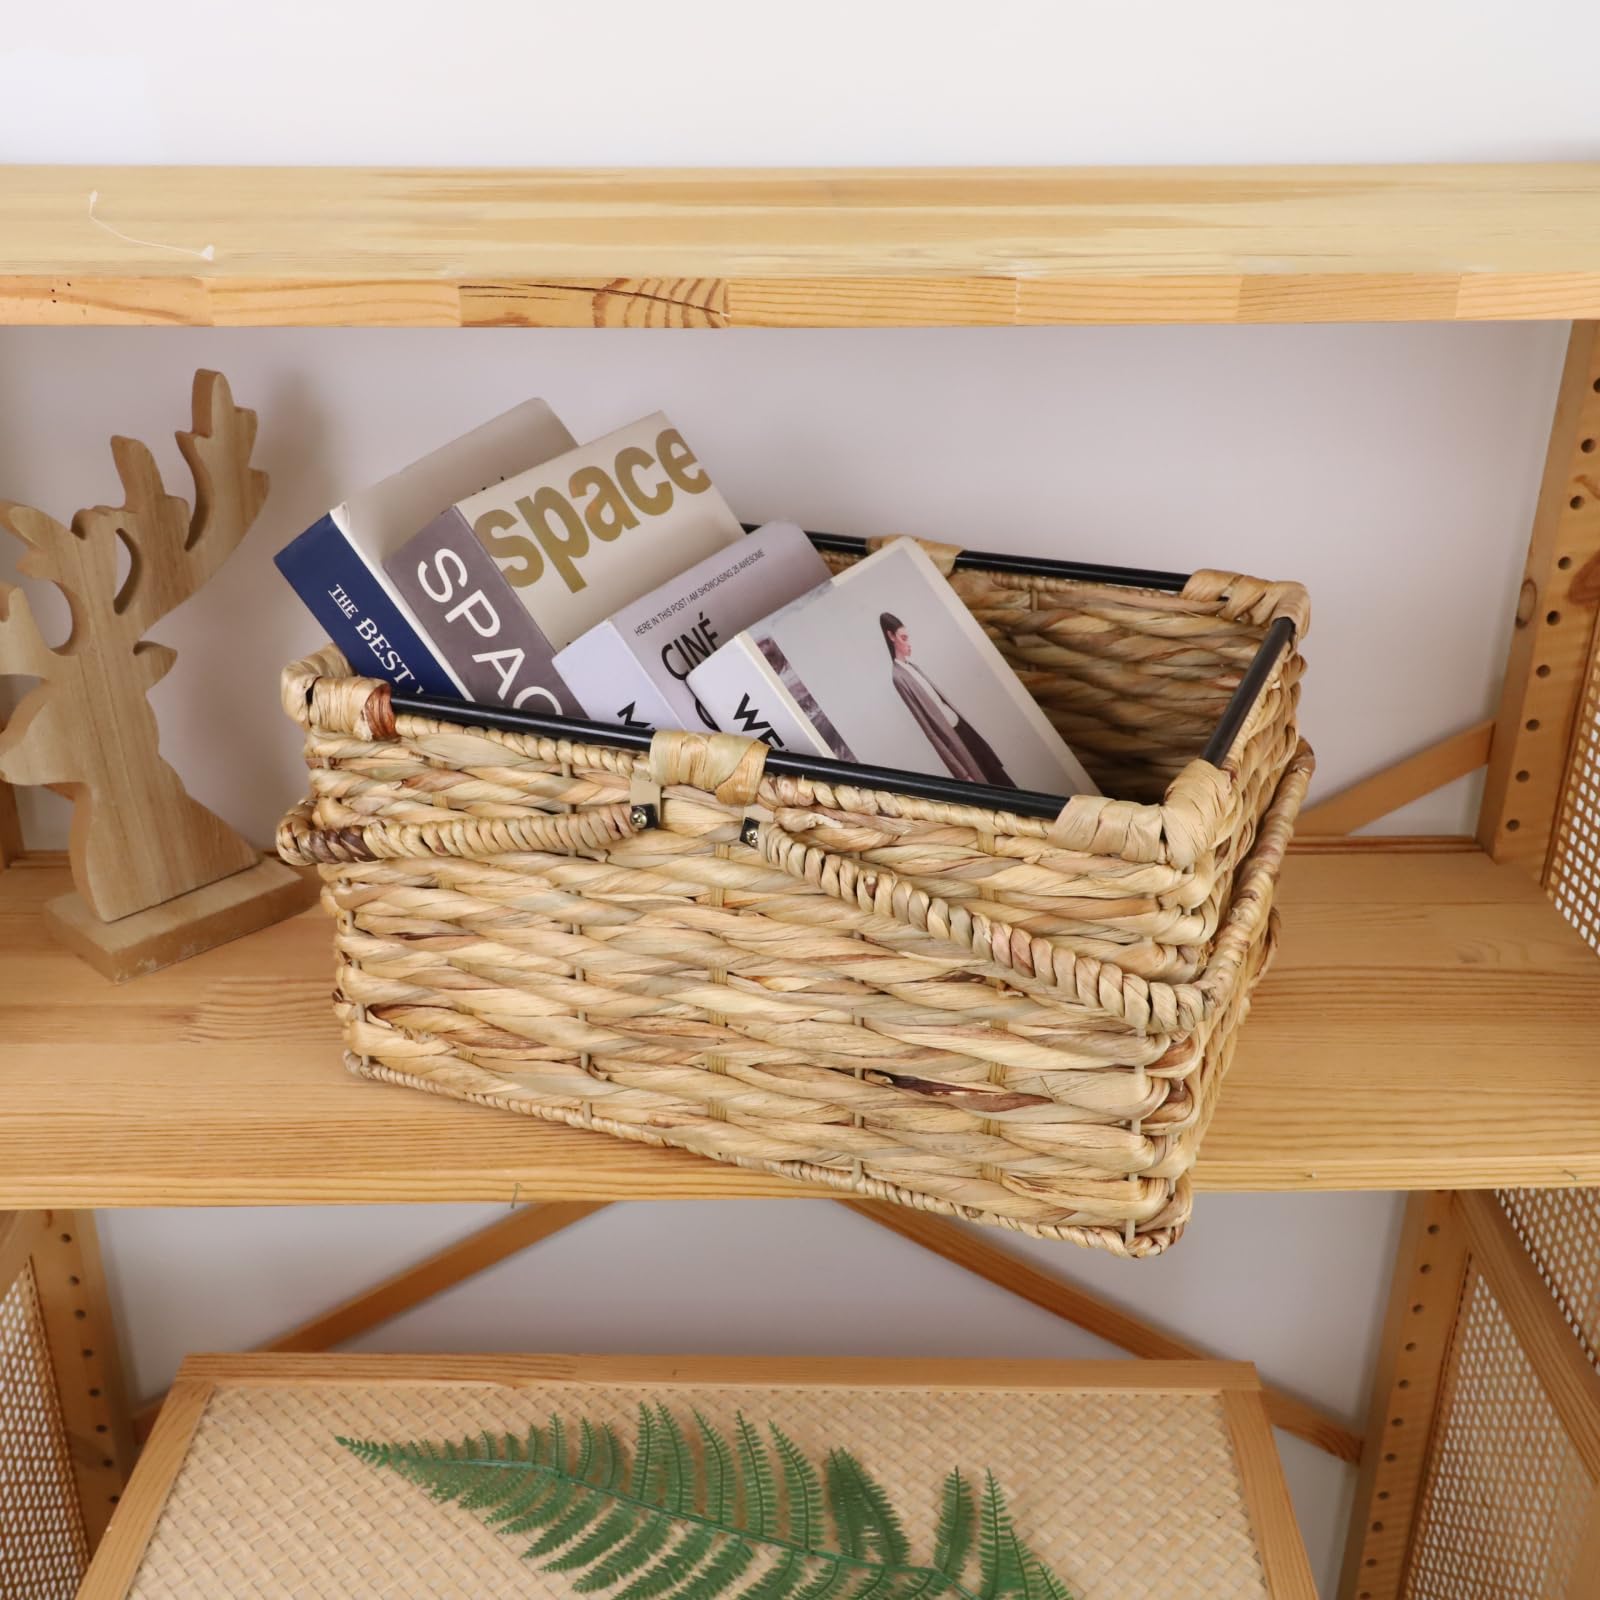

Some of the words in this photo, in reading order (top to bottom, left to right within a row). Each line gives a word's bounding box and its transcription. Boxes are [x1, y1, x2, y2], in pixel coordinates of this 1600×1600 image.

[473, 428, 712, 593] space
[328, 584, 359, 619] THE
[355, 617, 416, 684] BEST
[634, 621, 653, 636] HERE
[650, 616, 660, 626] IN
[657, 608, 673, 622] THIS
[670, 598, 687, 614] POST
[689, 591, 699, 601] AM
[697, 569, 734, 597] SHOWCASING
[738, 549, 766, 570] AWESOME
[733, 693, 787, 750] WE
